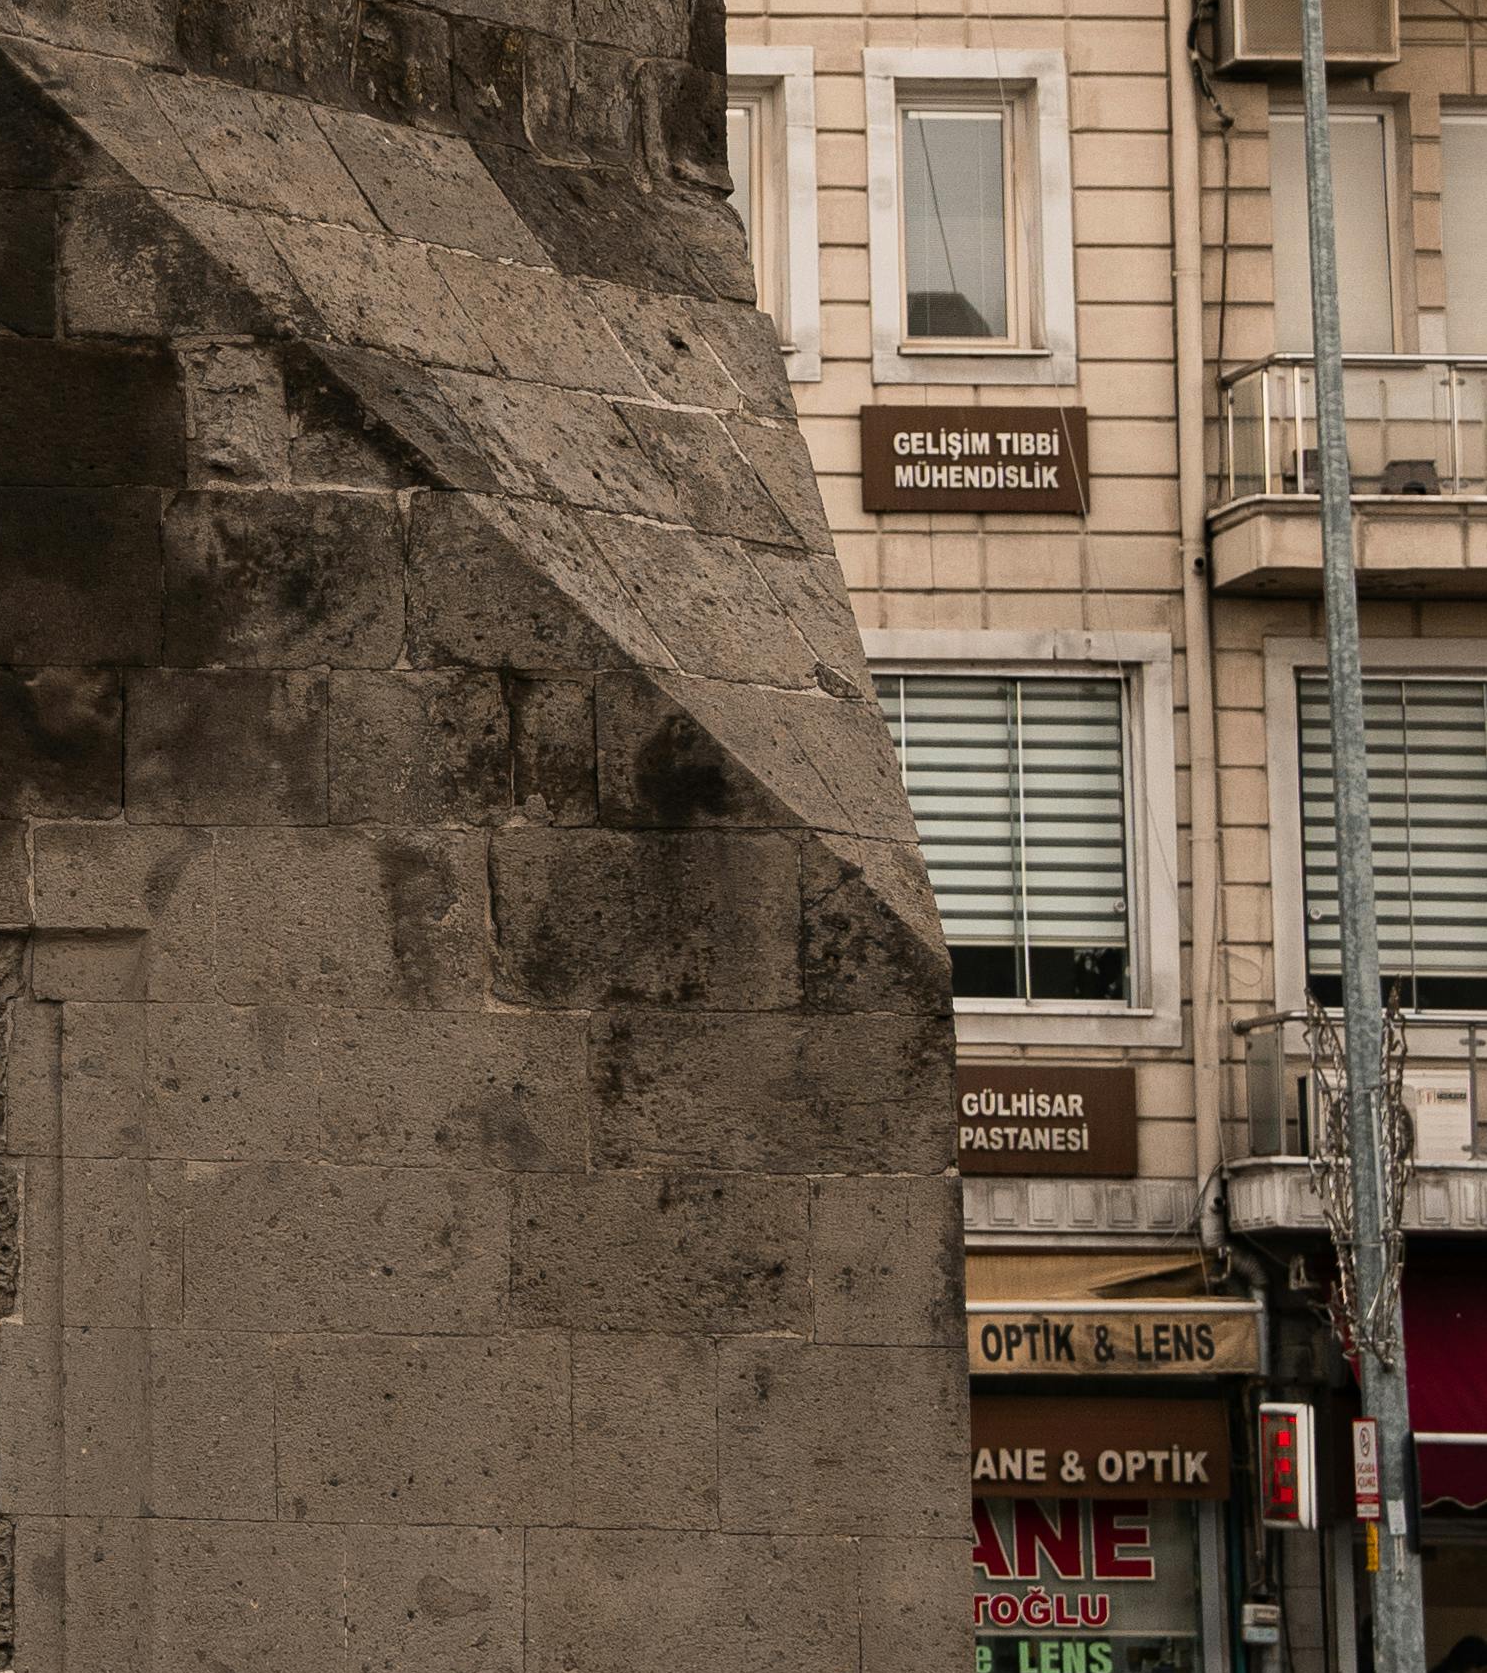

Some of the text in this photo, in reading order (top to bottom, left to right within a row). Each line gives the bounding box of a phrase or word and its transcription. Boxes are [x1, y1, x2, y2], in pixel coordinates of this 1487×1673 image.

[893, 427, 1060, 460] GELİŞİM TIBBİ
[894, 461, 1059, 488] MÜHENDİSLİK
[961, 1088, 1084, 1118] GÜLHİSAR
[959, 1123, 1089, 1151] PASTANESİ
[981, 1318, 1215, 1363] OPTİK & LENS
[973, 1443, 1210, 1484] ANE & OPTİK
